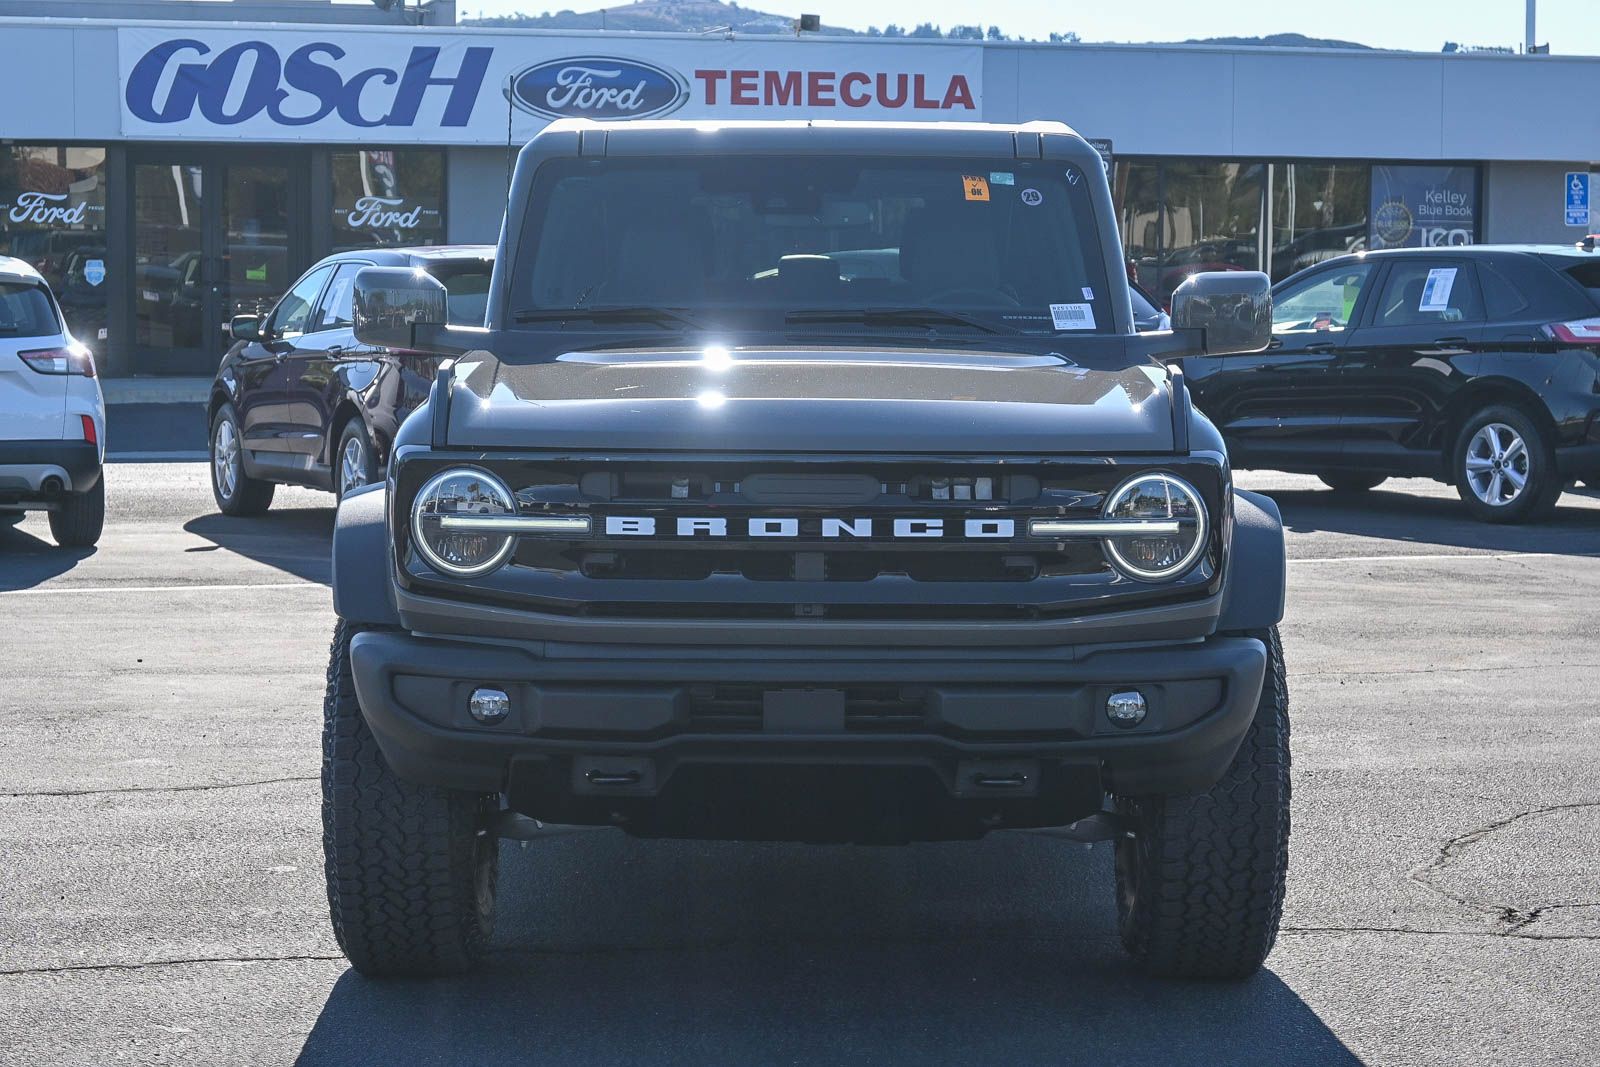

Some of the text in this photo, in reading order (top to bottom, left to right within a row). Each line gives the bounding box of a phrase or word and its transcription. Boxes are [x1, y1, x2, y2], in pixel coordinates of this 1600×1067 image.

[546, 66, 647, 110] Ford
[694, 69, 976, 109] TEMECULA
[971, 188, 983, 196] OK
[1425, 190, 1467, 206] Kelley
[9, 191, 87, 224] Ford
[347, 196, 422, 228] Ford
[1418, 204, 1472, 216] Blue Book
[605, 516, 1015, 538] BRONCO
